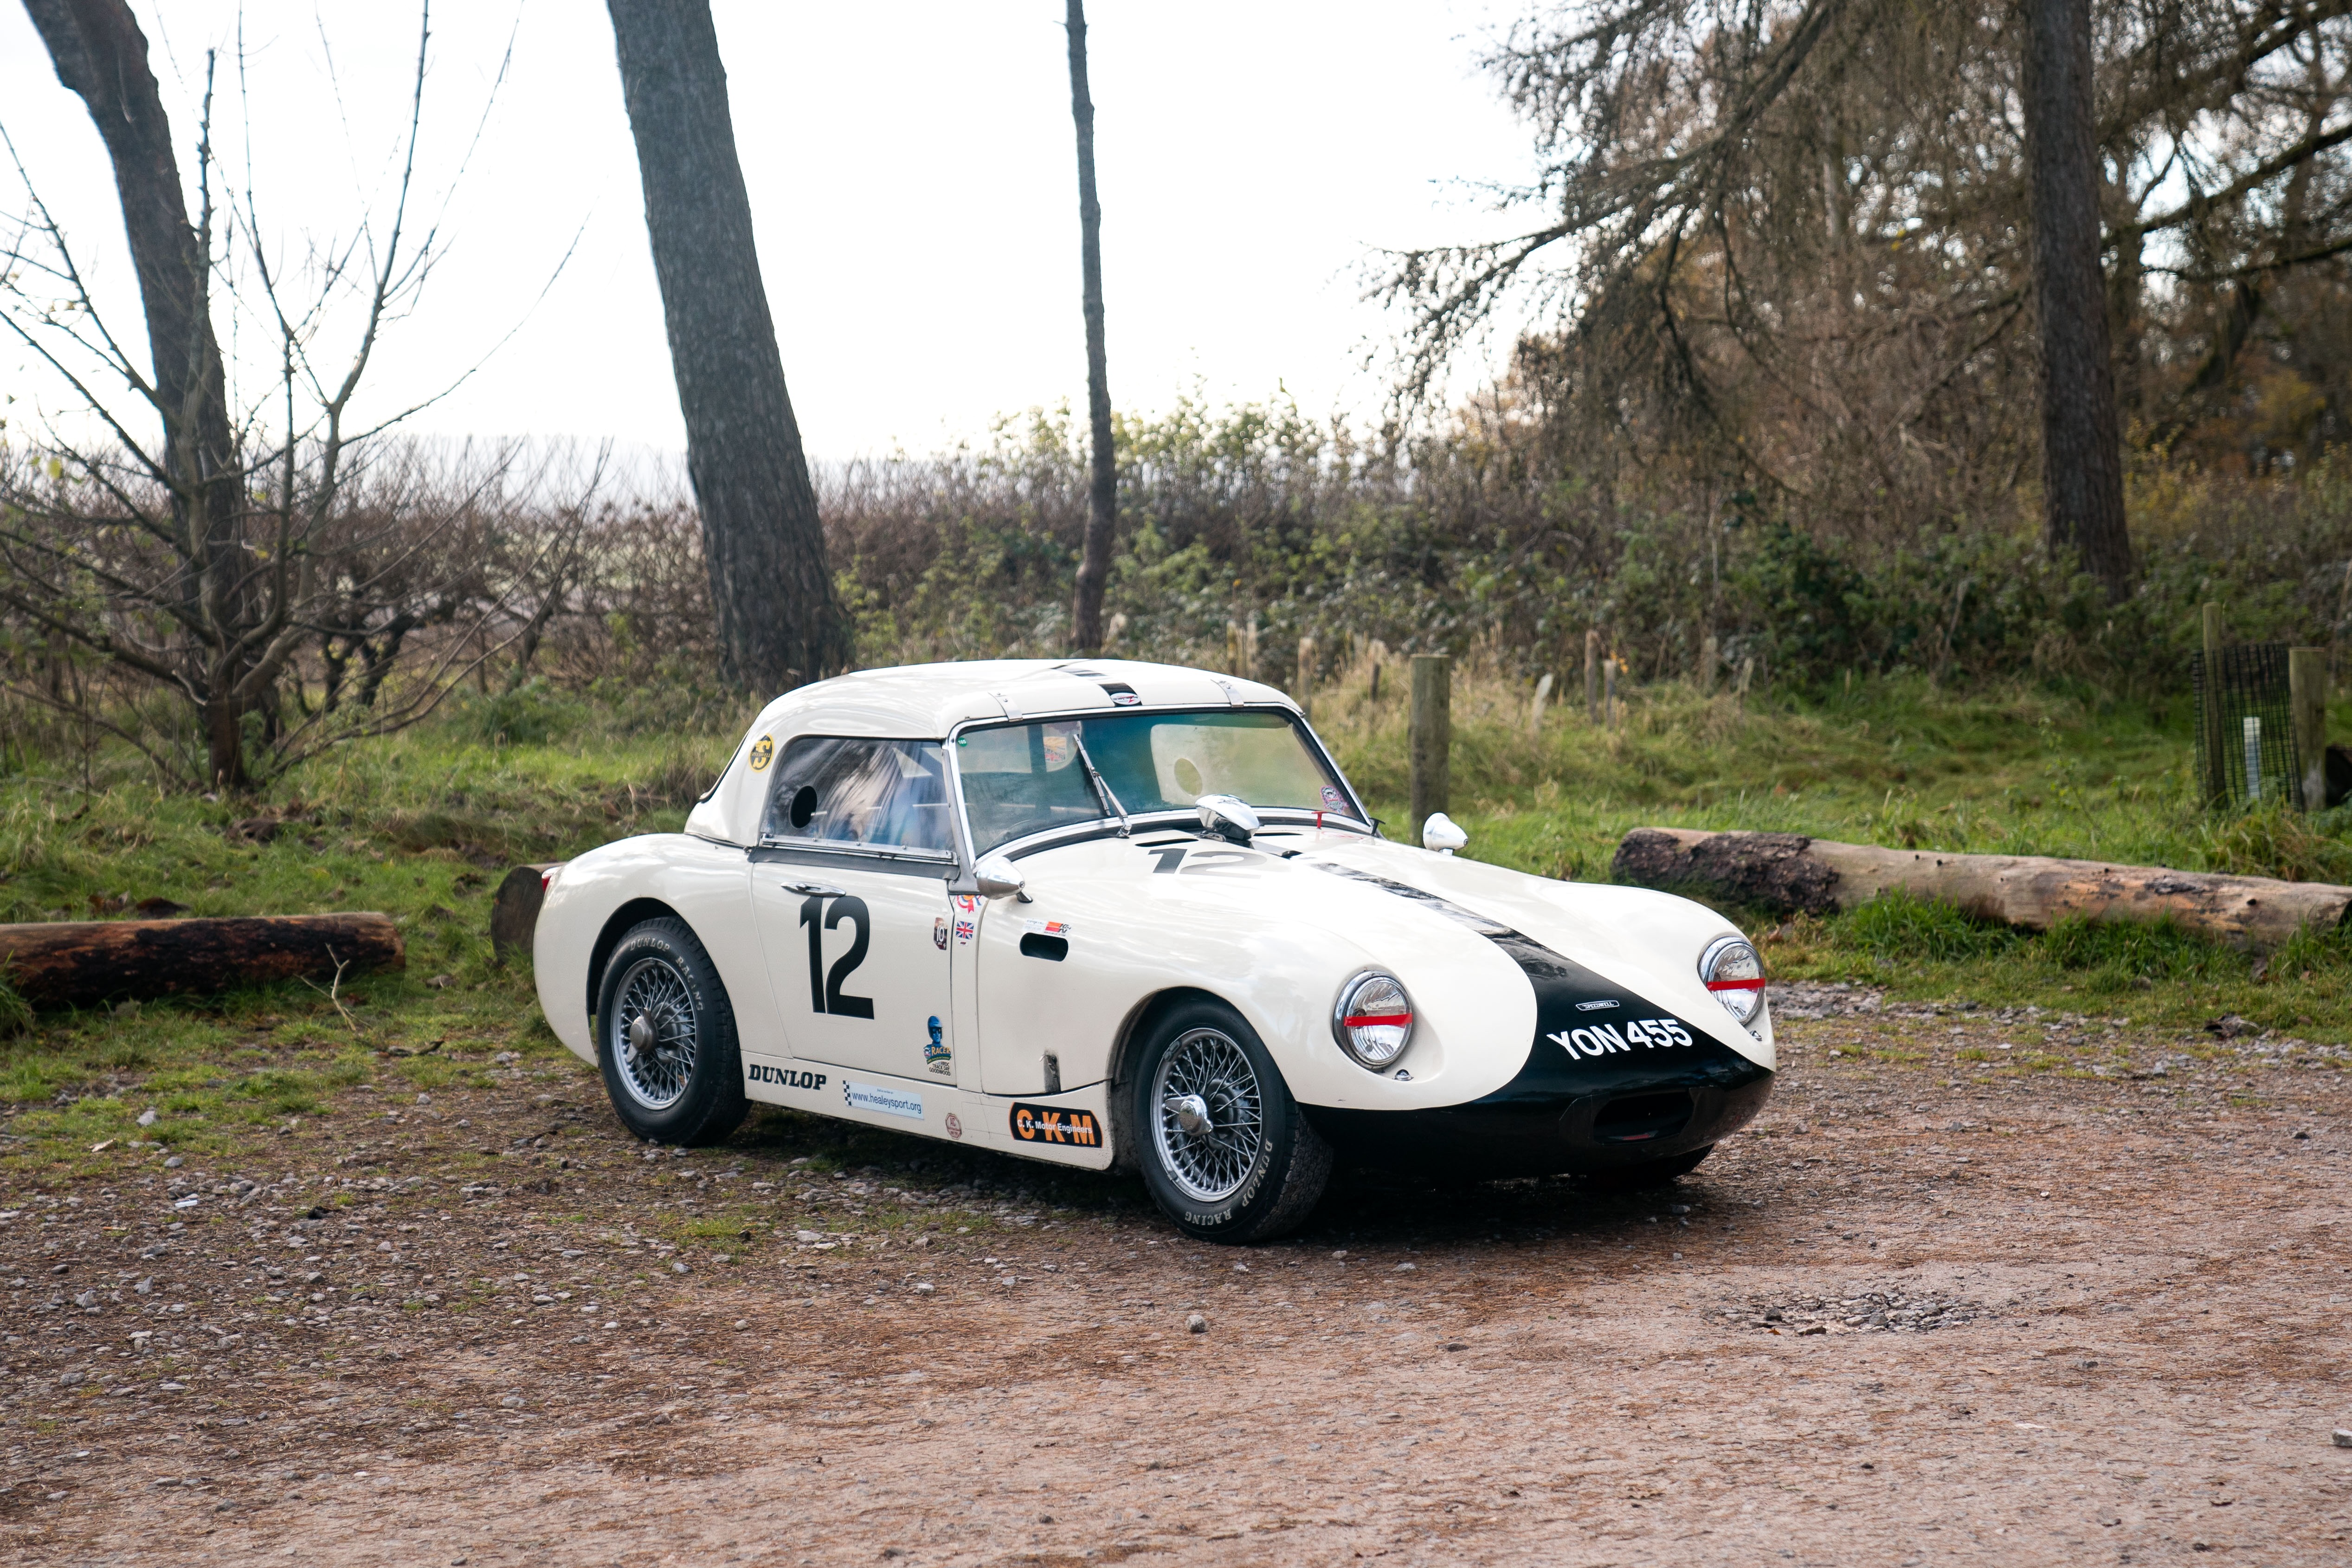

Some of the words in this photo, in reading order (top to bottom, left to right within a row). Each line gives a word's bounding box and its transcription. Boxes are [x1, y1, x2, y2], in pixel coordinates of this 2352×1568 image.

[1148, 848, 1267, 879] 12
[630, 937, 670, 951] DUNLOP
[799, 896, 875, 1020] 12
[1547, 1024, 1631, 1060] YON
[1628, 1019, 1693, 1048] 455
[931, 1046, 950, 1056] RACER
[748, 1064, 827, 1091] DUNLOP
[929, 1067, 951, 1076] GOODWOOD
[851, 1092, 921, 1114] www.healeysport.org
[1035, 1121, 1056, 1130] Motor
[1057, 1123, 1093, 1134] Engineers
[1242, 1138, 1273, 1207] DUNLOP
[1184, 1208, 1232, 1226] RACING
